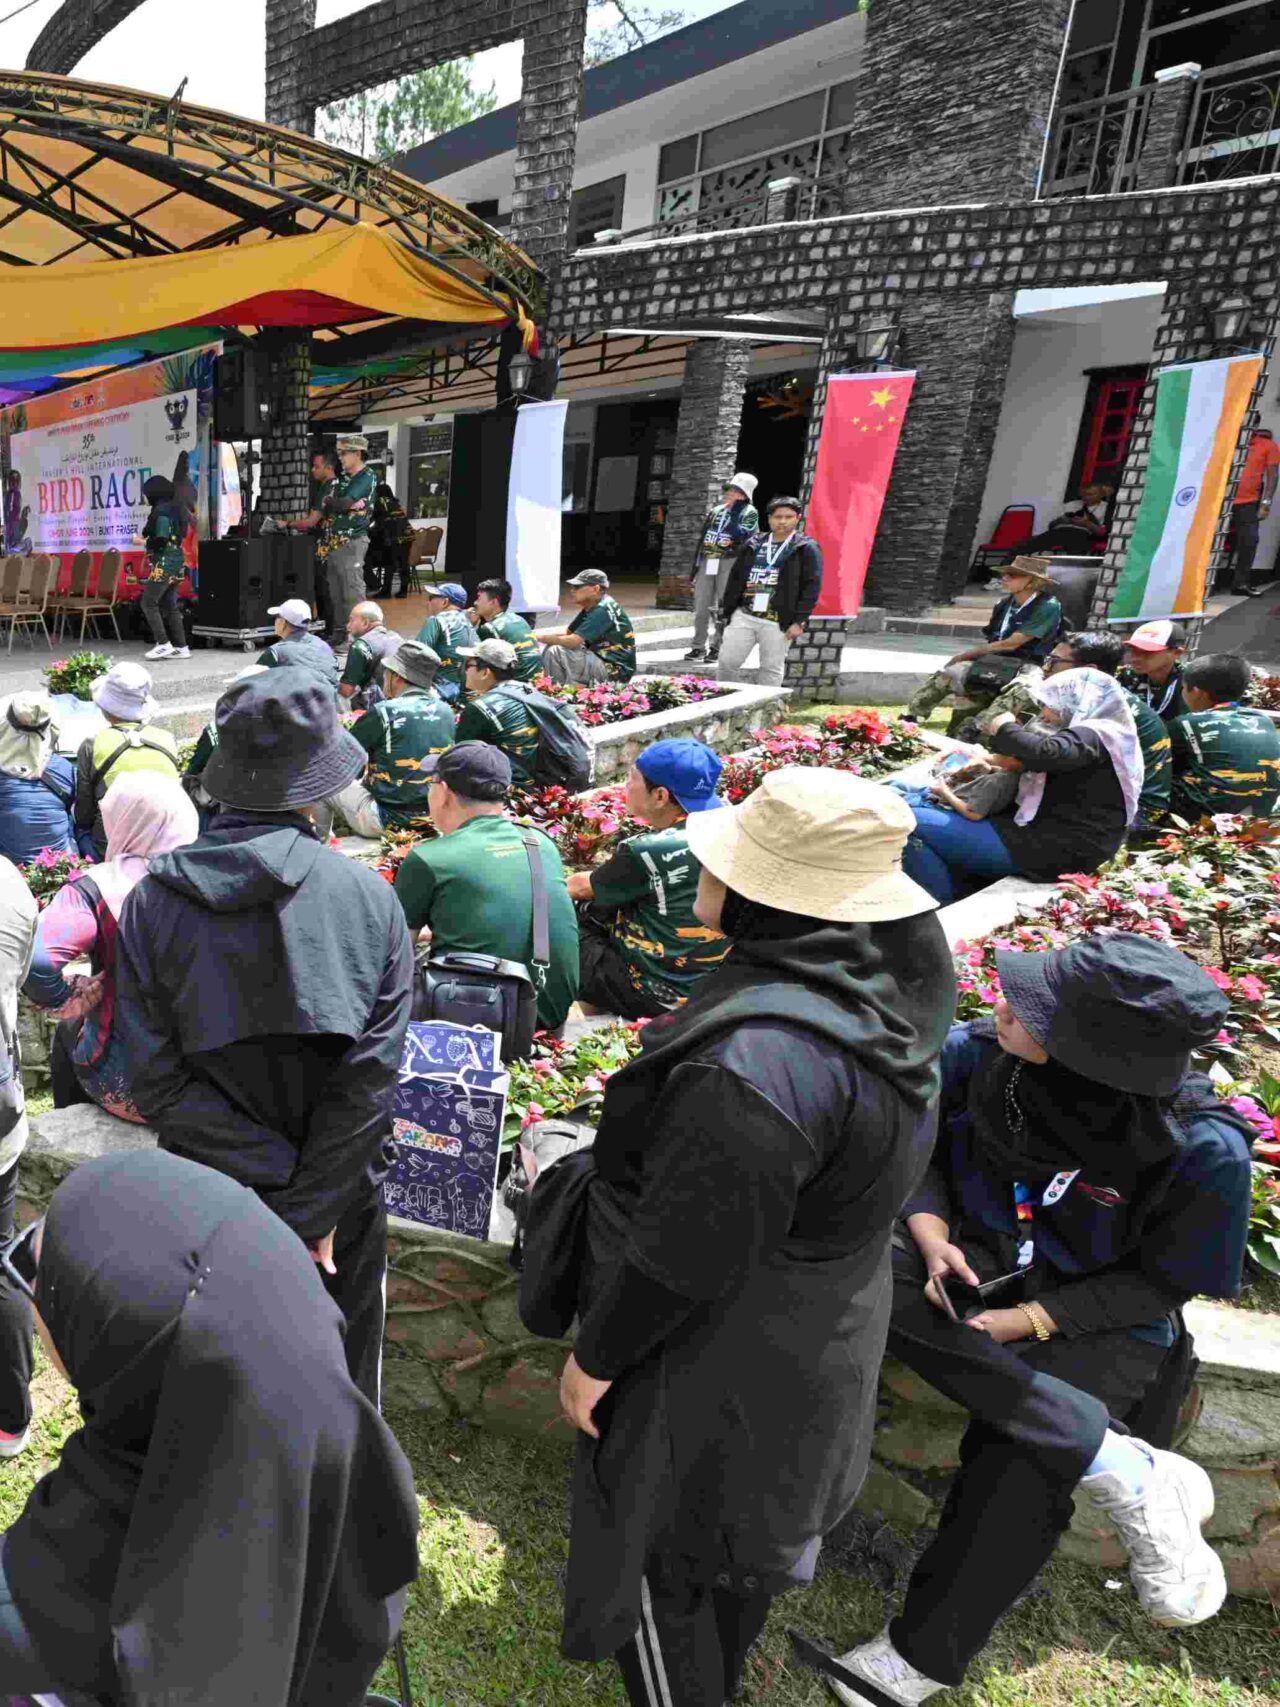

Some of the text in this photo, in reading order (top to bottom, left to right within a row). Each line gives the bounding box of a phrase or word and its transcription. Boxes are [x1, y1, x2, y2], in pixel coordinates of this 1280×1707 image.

[87, 456, 143, 473] INTERNATIONAL
[37, 476, 85, 514] BIRD
[99, 525, 114, 536] BUKIT
[116, 523, 138, 535] FRASER
